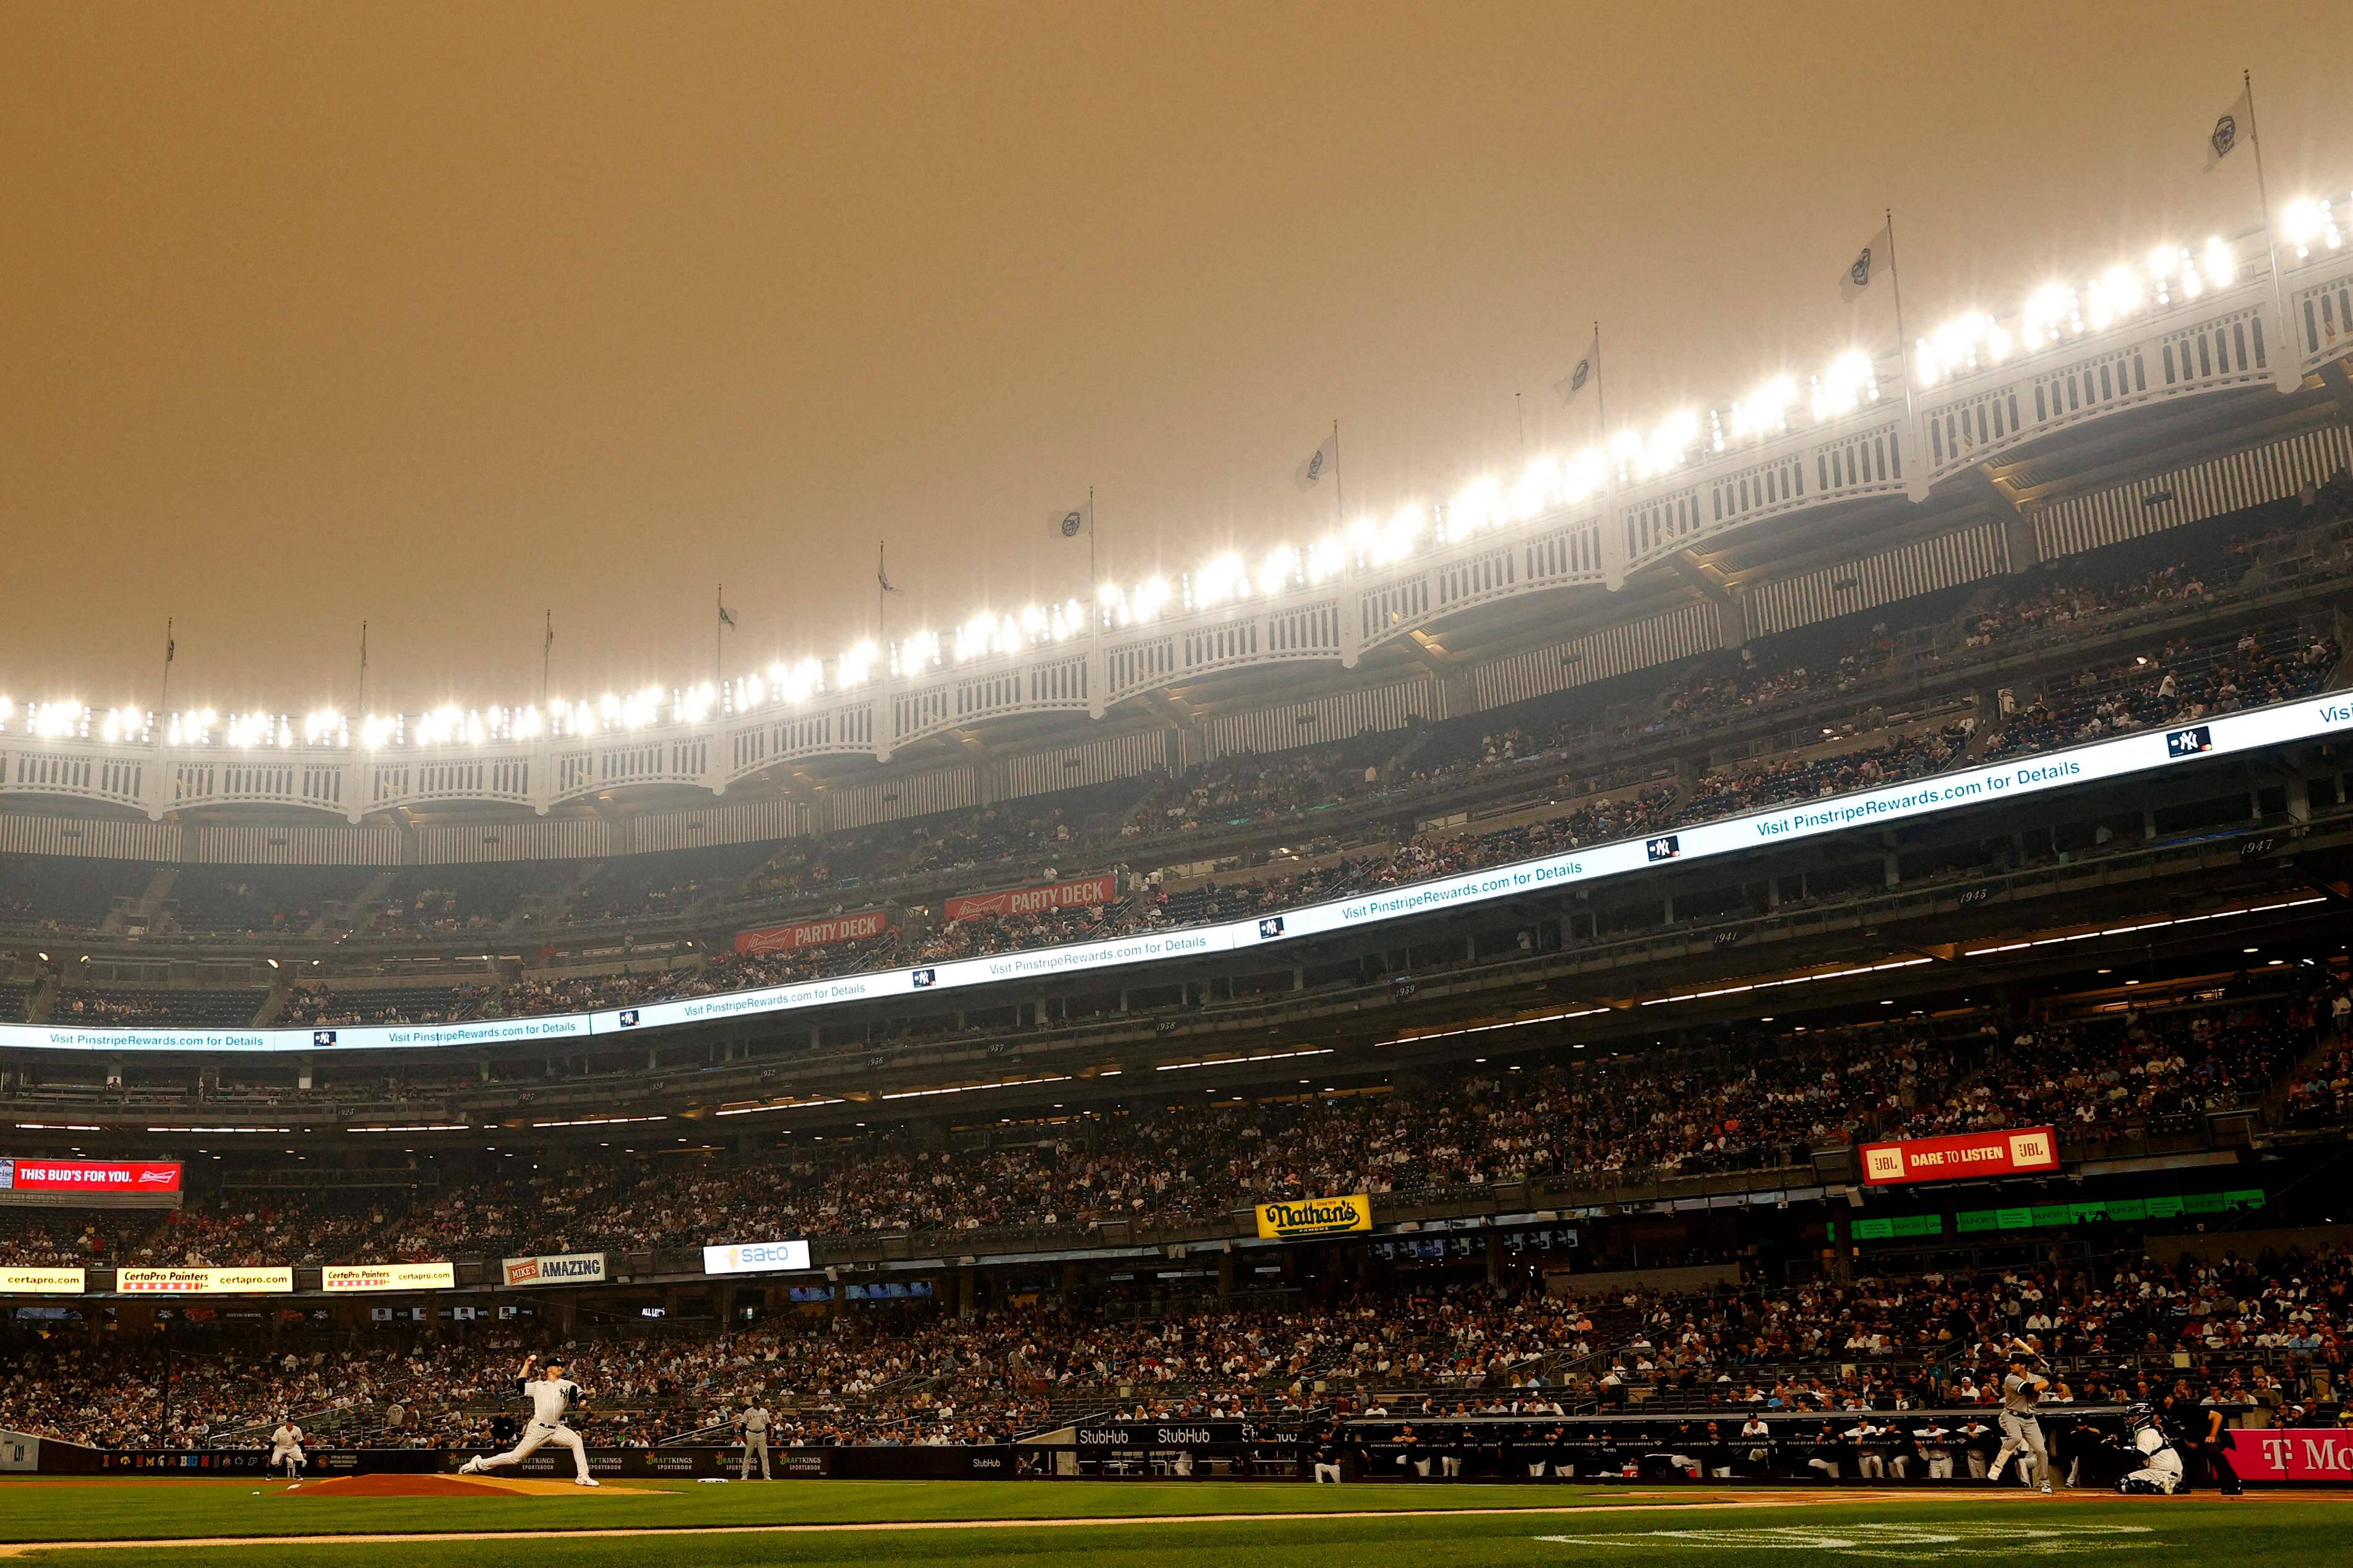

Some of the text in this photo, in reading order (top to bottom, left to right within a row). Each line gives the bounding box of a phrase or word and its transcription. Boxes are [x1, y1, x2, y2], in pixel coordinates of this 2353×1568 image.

[1757, 761, 2080, 837] Visit PinstripeRewards.com for Details
[2242, 839, 2274, 855] 1947
[1011, 889, 1058, 913] PARTY
[1062, 881, 1104, 904] DECK
[1342, 862, 1582, 920] Visit PinstripeRewards.com for Details
[795, 922, 836, 946] PARTY
[840, 916, 877, 938] DECK
[990, 936, 1206, 975] Visit PinstripeRewards.com for Details
[685, 983, 865, 1017] Visit PinstripeRewards.com for Details
[50, 1034, 264, 1047] Visit PinstripeRewards.com for Details
[389, 1022, 576, 1043] Visit PinstripeRewards.com for Details
[1910, 1146, 2004, 1167] DARE TO LISTEN
[2019, 1143, 2043, 1157] JBL
[1875, 1157, 1897, 1171] JBL
[20, 1168, 46, 1180] THIS
[48, 1169, 82, 1181] BUD'S
[84, 1170, 107, 1182] FOR
[108, 1171, 132, 1183] YOU.
[1266, 1200, 1360, 1228] Nathan's
[742, 1246, 788, 1262] sato
[328, 1270, 390, 1279] CertaPro Painters
[398, 1272, 450, 1280] certapro.com
[512, 1265, 536, 1279] MIKE'S
[542, 1259, 601, 1277] AMAZING
[7, 1275, 80, 1285] certapro.com
[124, 1272, 208, 1281] CertaPro Painters
[220, 1275, 288, 1284] certapro.com
[1079, 1429, 1129, 1445] StubHub
[1157, 1428, 1210, 1444] StubHub
[646, 1456, 693, 1465] DRAFTKINGS
[779, 1456, 821, 1465] DRAFTKINGS
[972, 1459, 1001, 1468] StubHub
